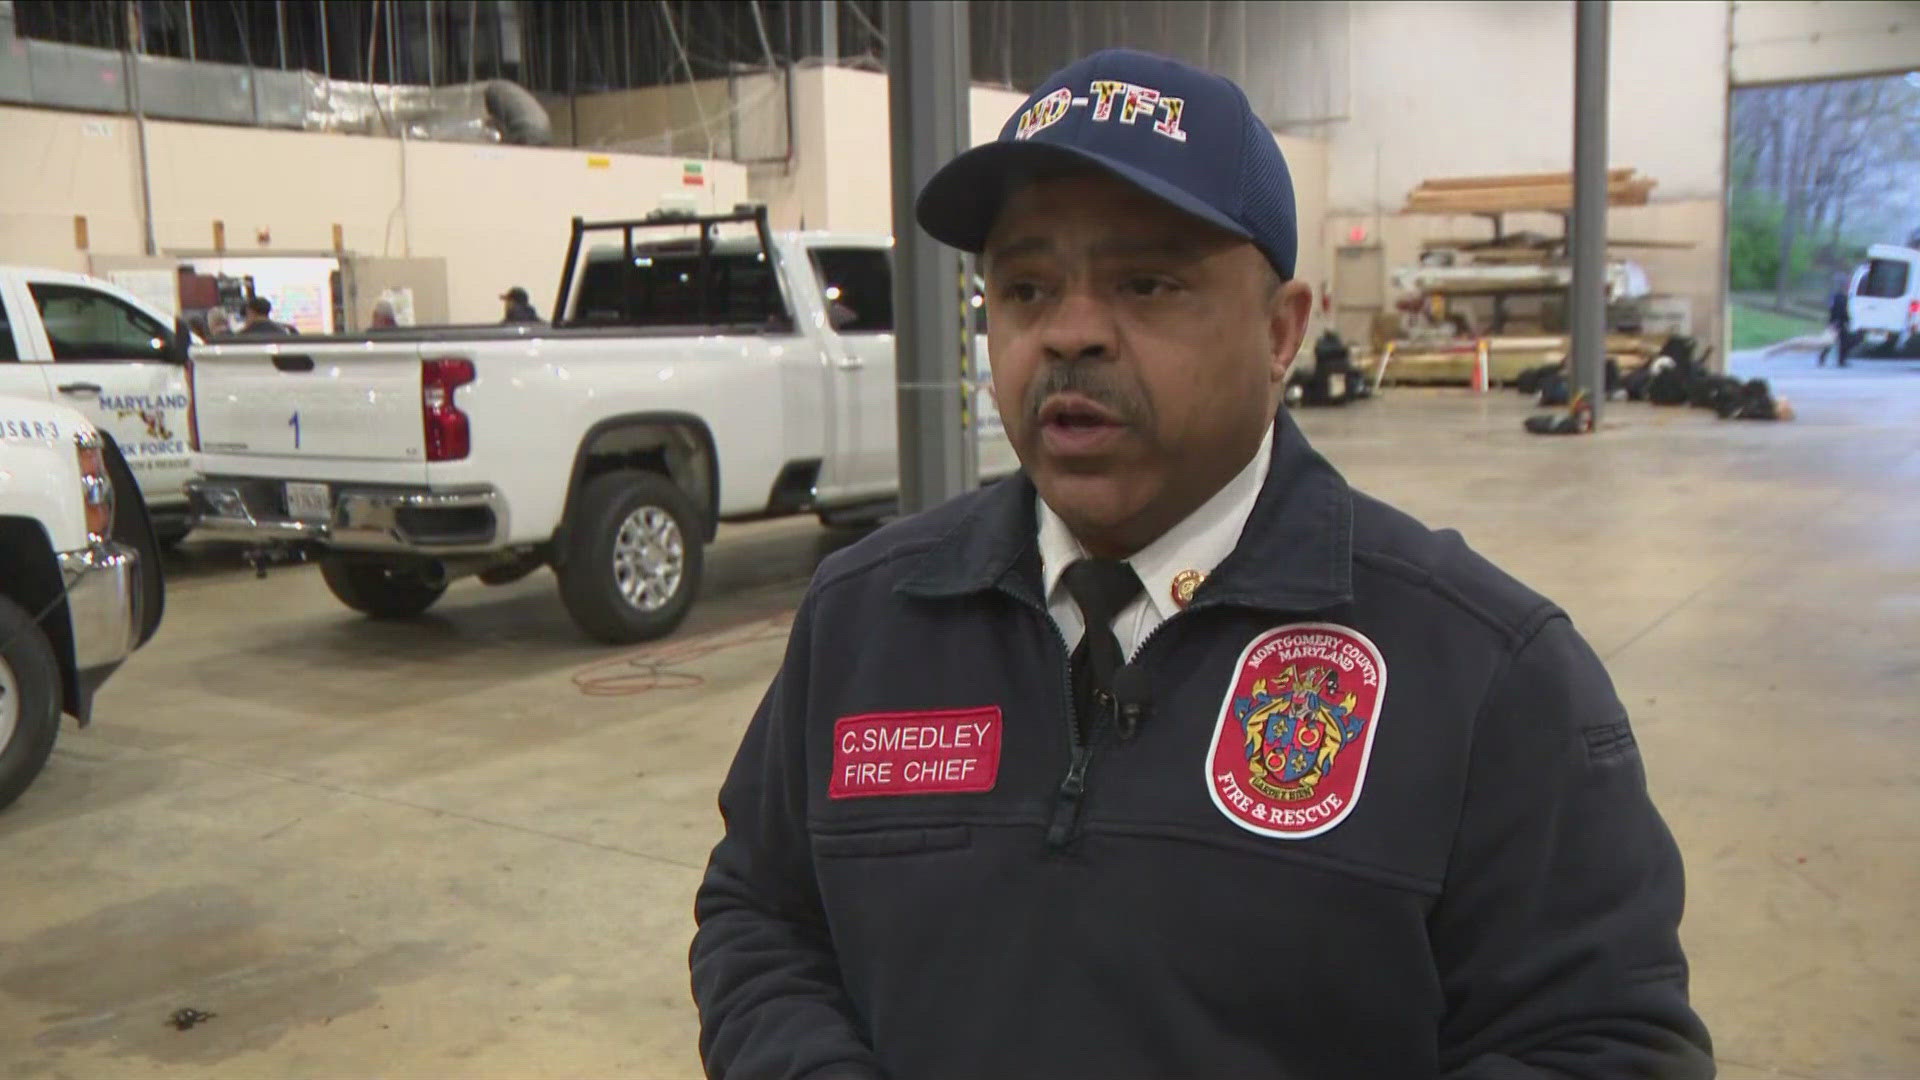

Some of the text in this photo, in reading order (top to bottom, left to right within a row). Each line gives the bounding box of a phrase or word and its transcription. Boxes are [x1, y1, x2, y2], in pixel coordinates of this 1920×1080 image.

[99, 394, 187, 410] MARYLAND
[288, 411, 301, 449] 1
[1248, 635, 1377, 687] MONTGOMERY COUNTY
[1278, 646, 1355, 672] MARYLAND
[841, 721, 992, 754] C.SMEDLEY
[844, 759, 977, 786] FIRE CHIEF
[1217, 771, 1343, 825] FIRE & RESCUE
